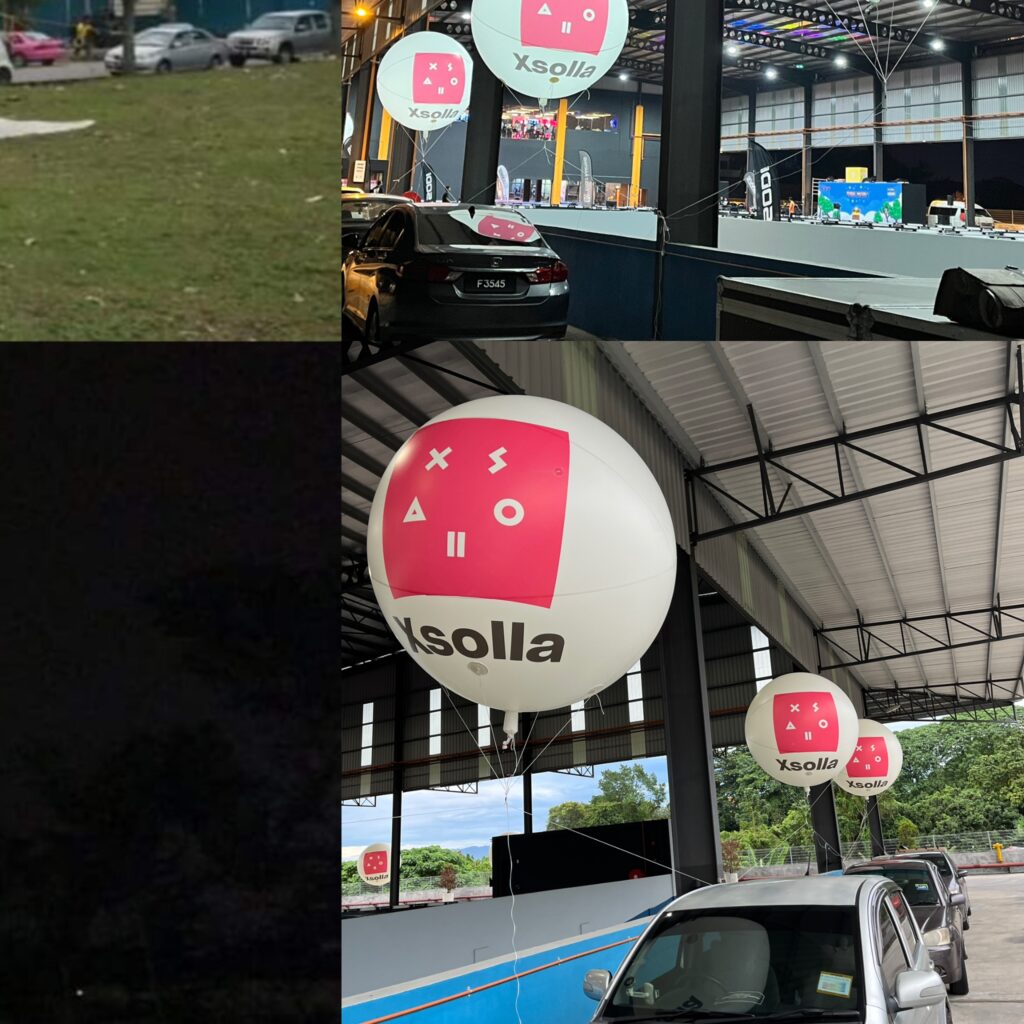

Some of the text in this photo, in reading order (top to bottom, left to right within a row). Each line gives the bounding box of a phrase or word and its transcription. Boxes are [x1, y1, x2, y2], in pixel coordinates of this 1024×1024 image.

[512, 52, 597, 79] Xsolla
[408, 106, 459, 120] Xsolla
[476, 279, 506, 289] F3545
[392, 616, 565, 663] Xsolla
[776, 757, 839, 772] Xsolla
[846, 779, 889, 789] Xsolla
